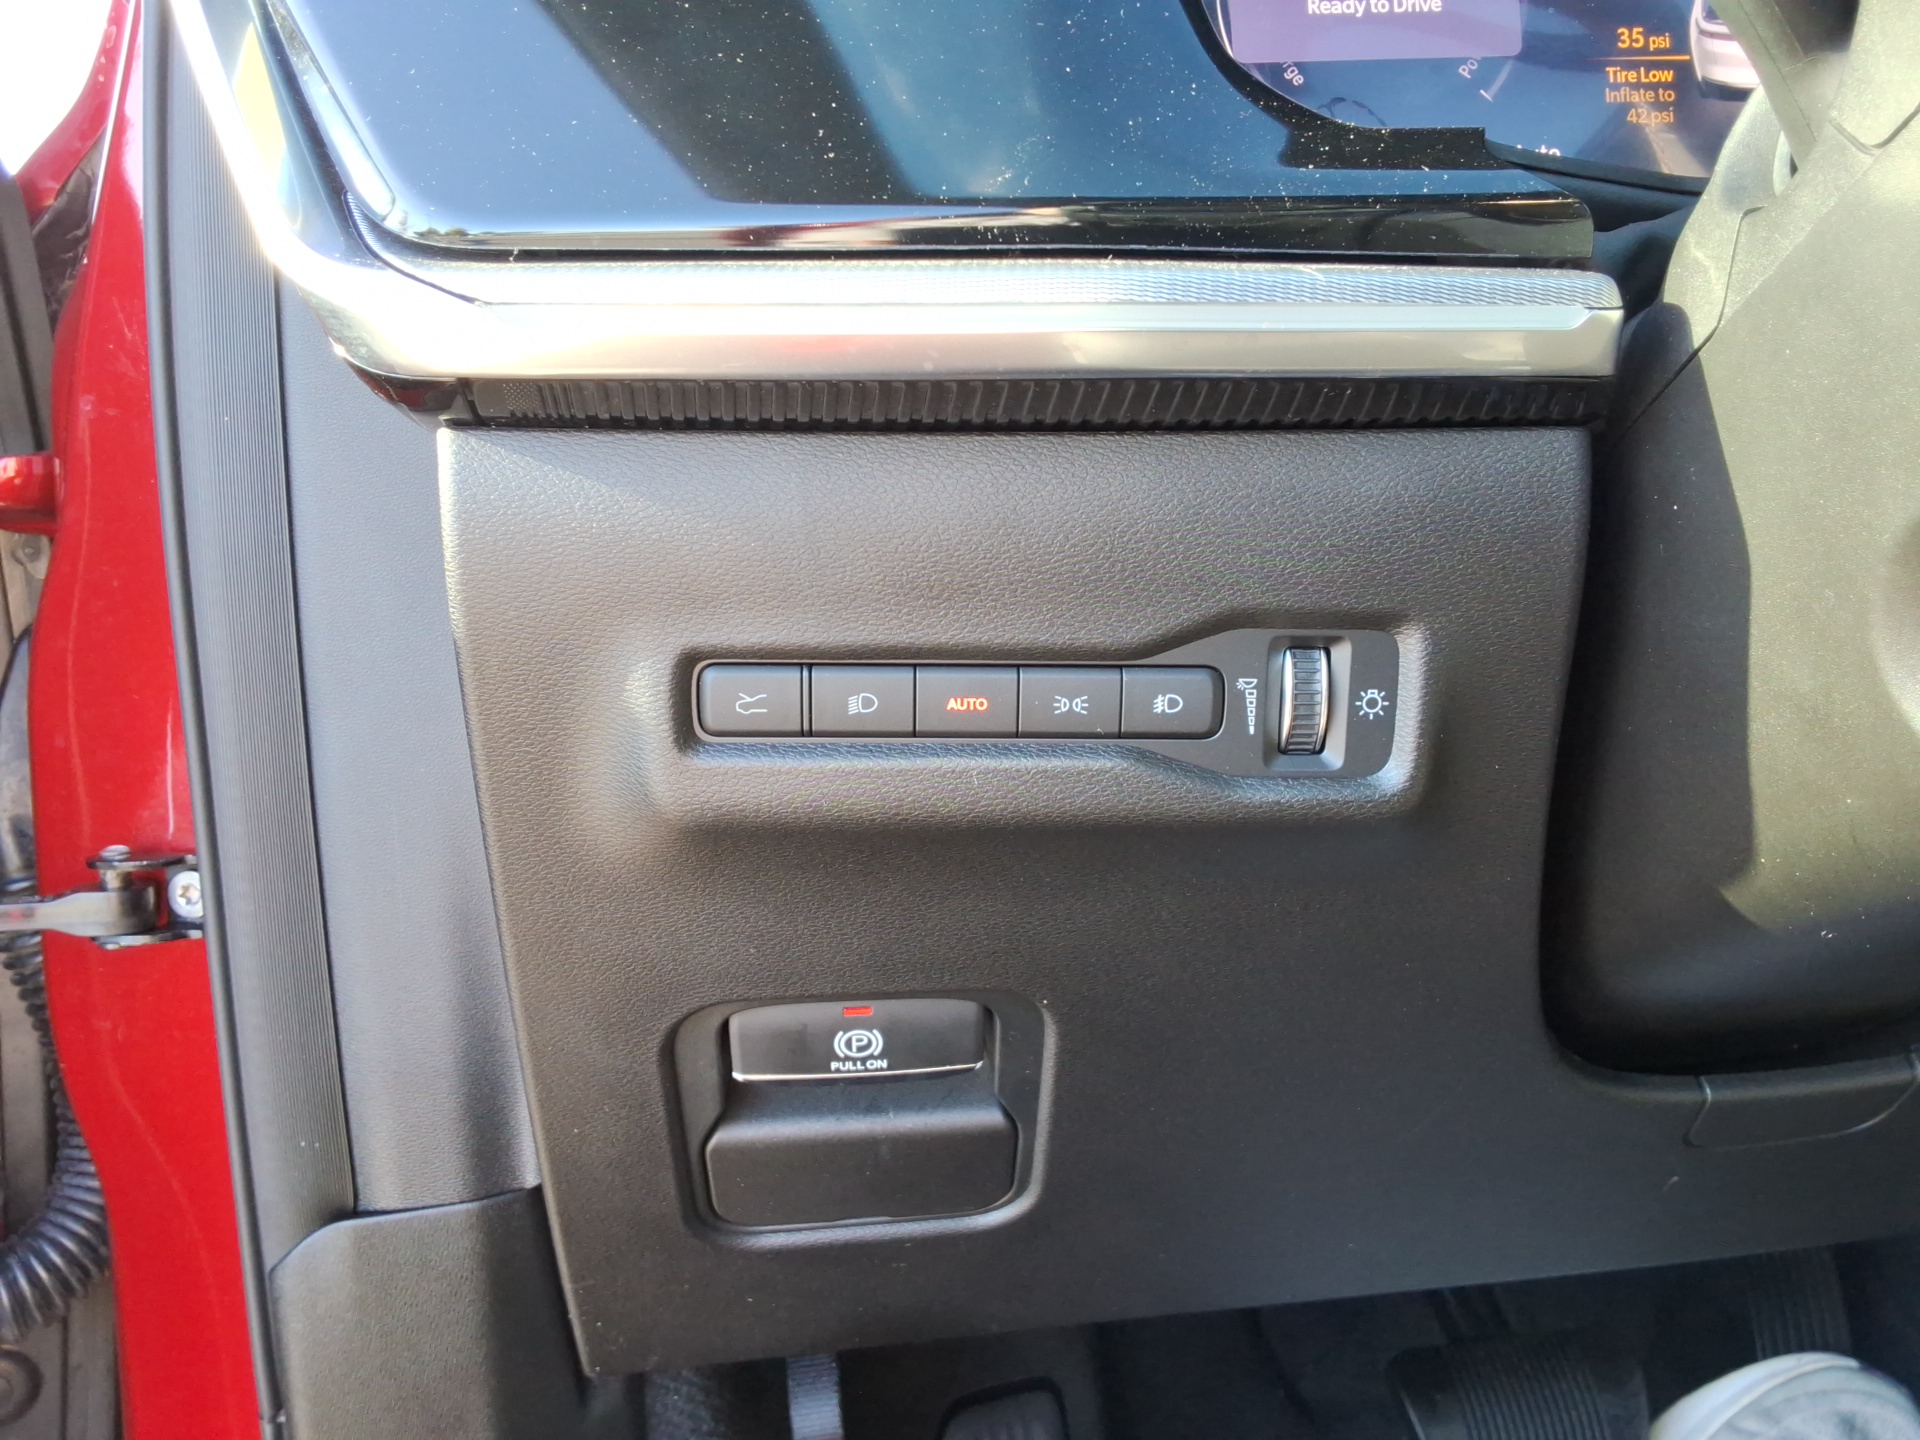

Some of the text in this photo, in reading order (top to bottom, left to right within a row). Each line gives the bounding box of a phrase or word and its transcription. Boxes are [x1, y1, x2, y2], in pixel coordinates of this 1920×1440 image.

[1307, 0, 1442, 17] Ready to Drive
[1617, 27, 1670, 51] 35 psi
[1280, 61, 1304, 86] rge
[1458, 57, 1481, 79] Po
[1605, 66, 1673, 83] Tire Low
[1605, 86, 1675, 103] Inflate to
[1626, 106, 1674, 127] 42 psi
[946, 697, 988, 711] AUTO
[830, 1059, 888, 1071] PULL ON
